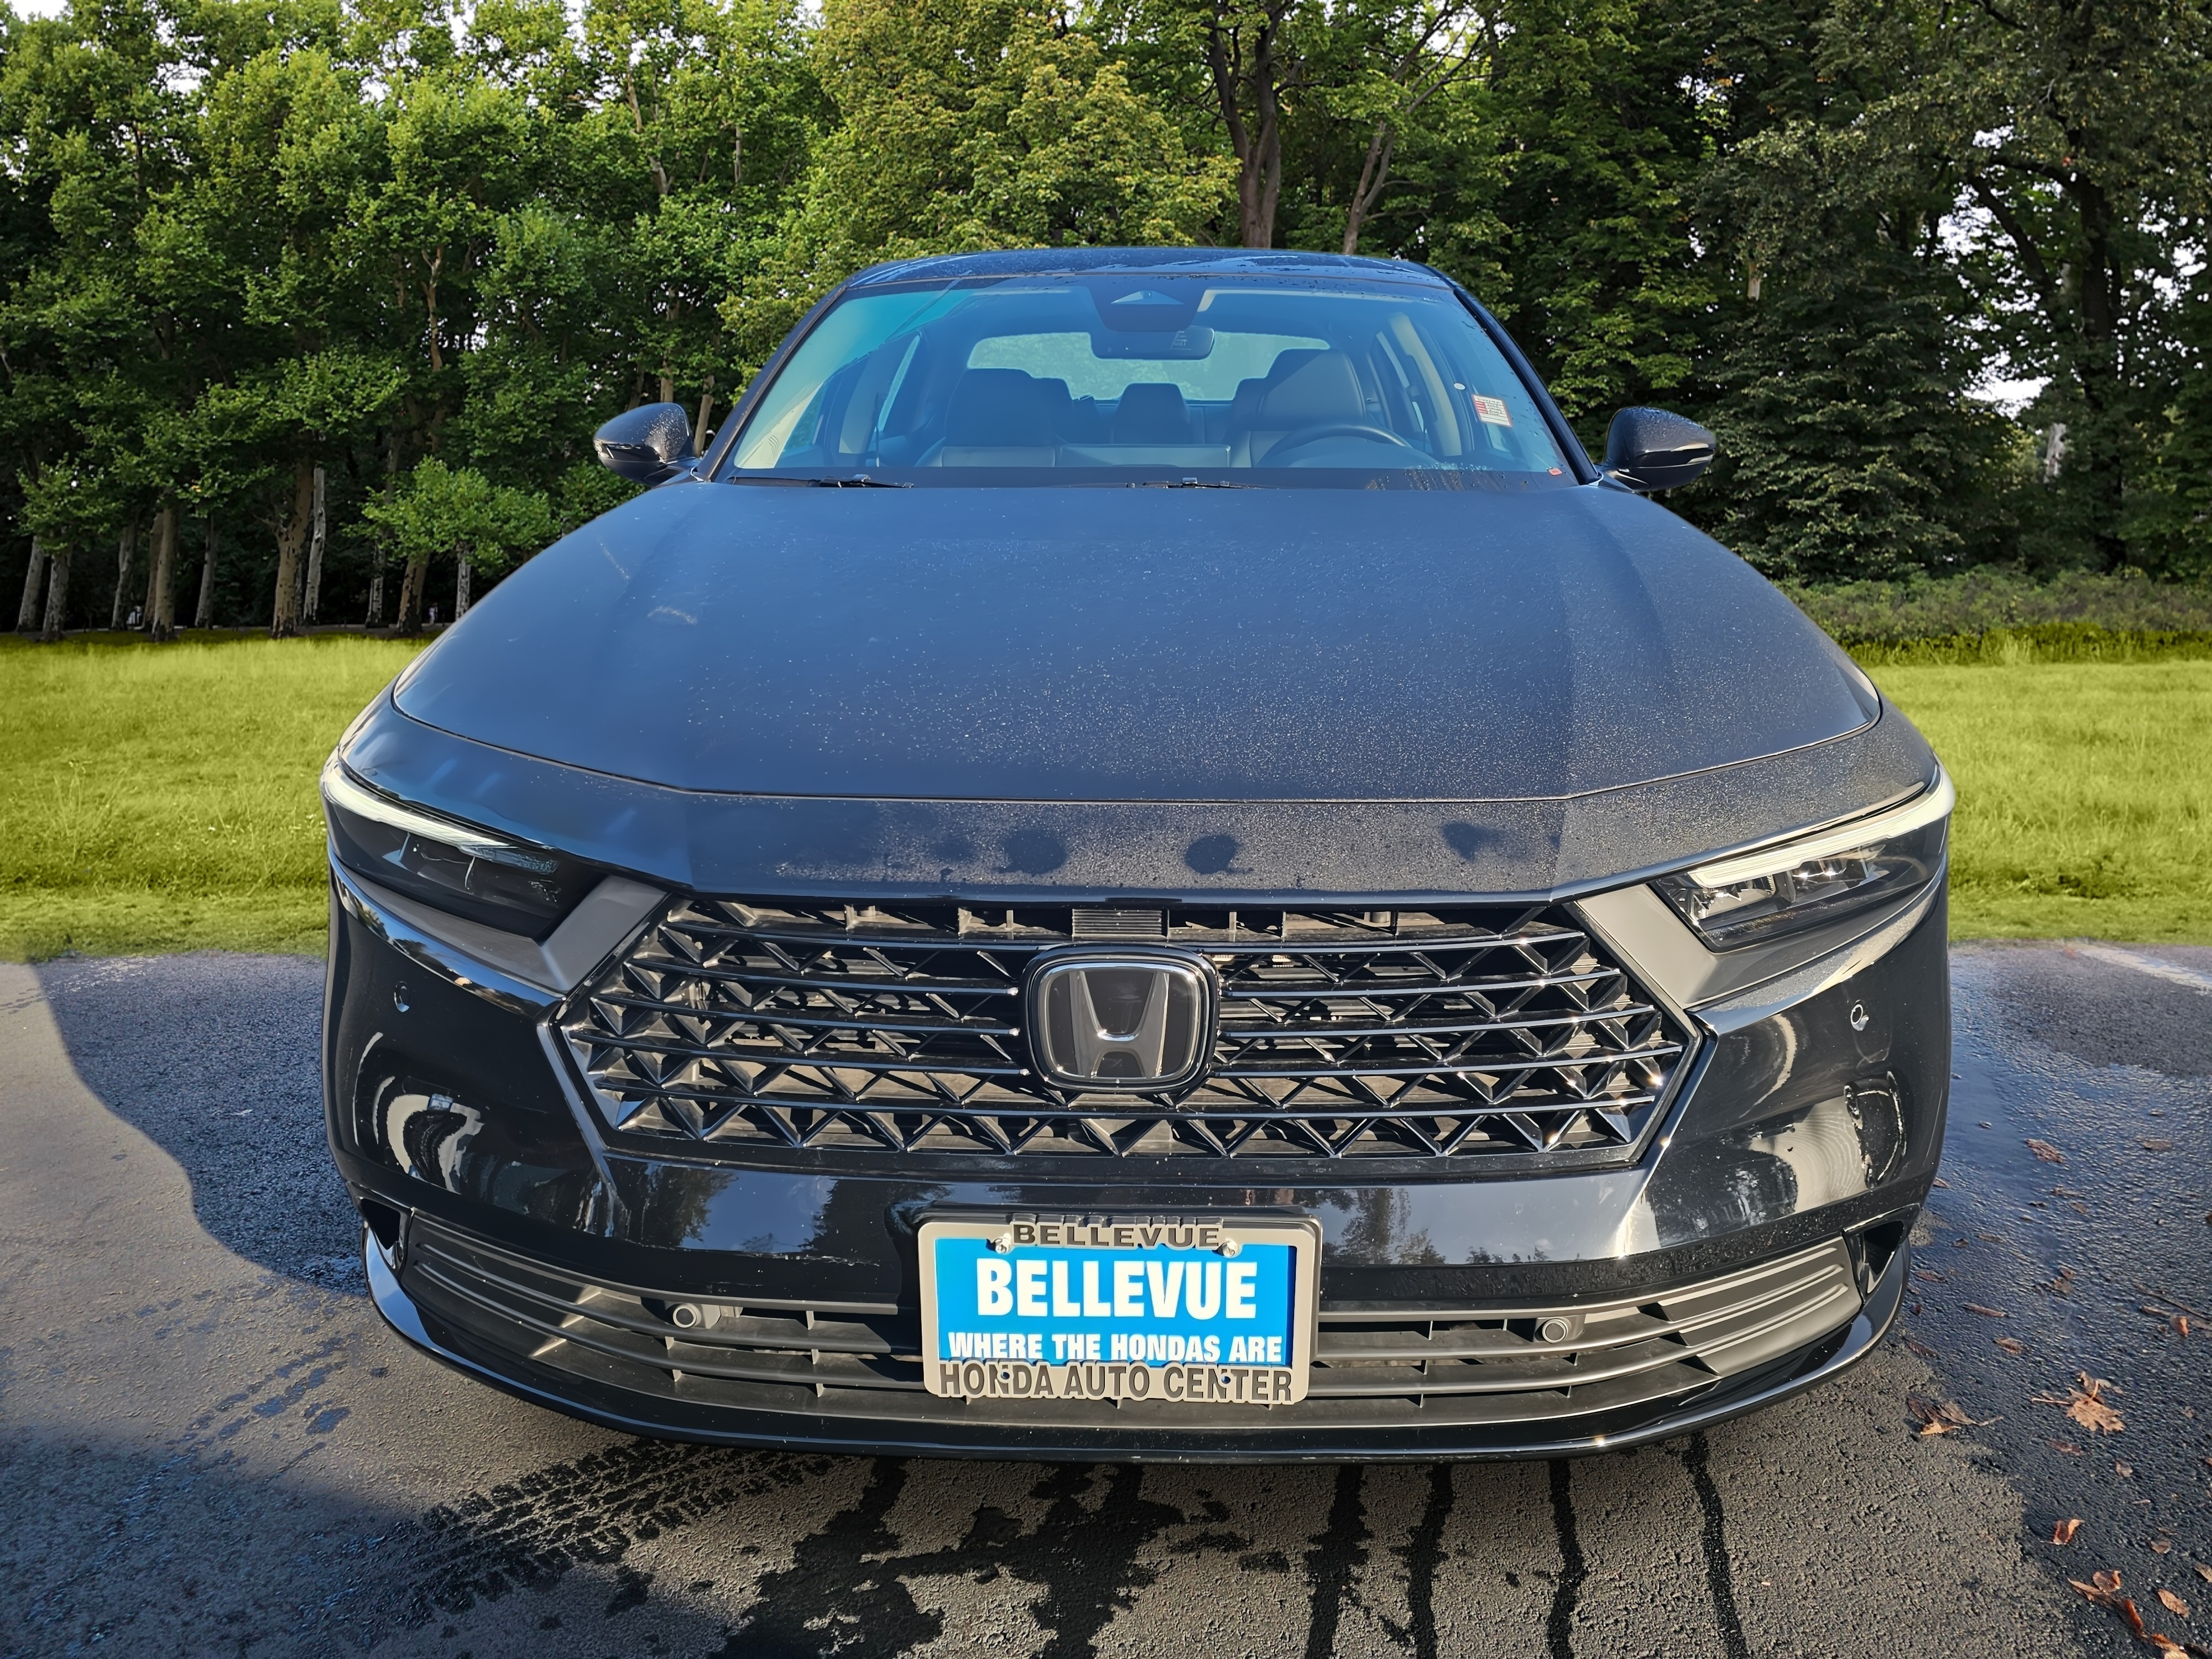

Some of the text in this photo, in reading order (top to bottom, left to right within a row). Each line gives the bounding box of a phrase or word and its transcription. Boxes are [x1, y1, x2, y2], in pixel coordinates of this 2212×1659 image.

[1069, 970, 1170, 1078] H
[1013, 1225, 1219, 1247] BELLEVUE
[976, 1258, 1258, 1320] BELLEVUE
[948, 1332, 1282, 1363] WHERE THE HONDAS ARE
[941, 1363, 1292, 1402] HONDA AUTO CENTER
